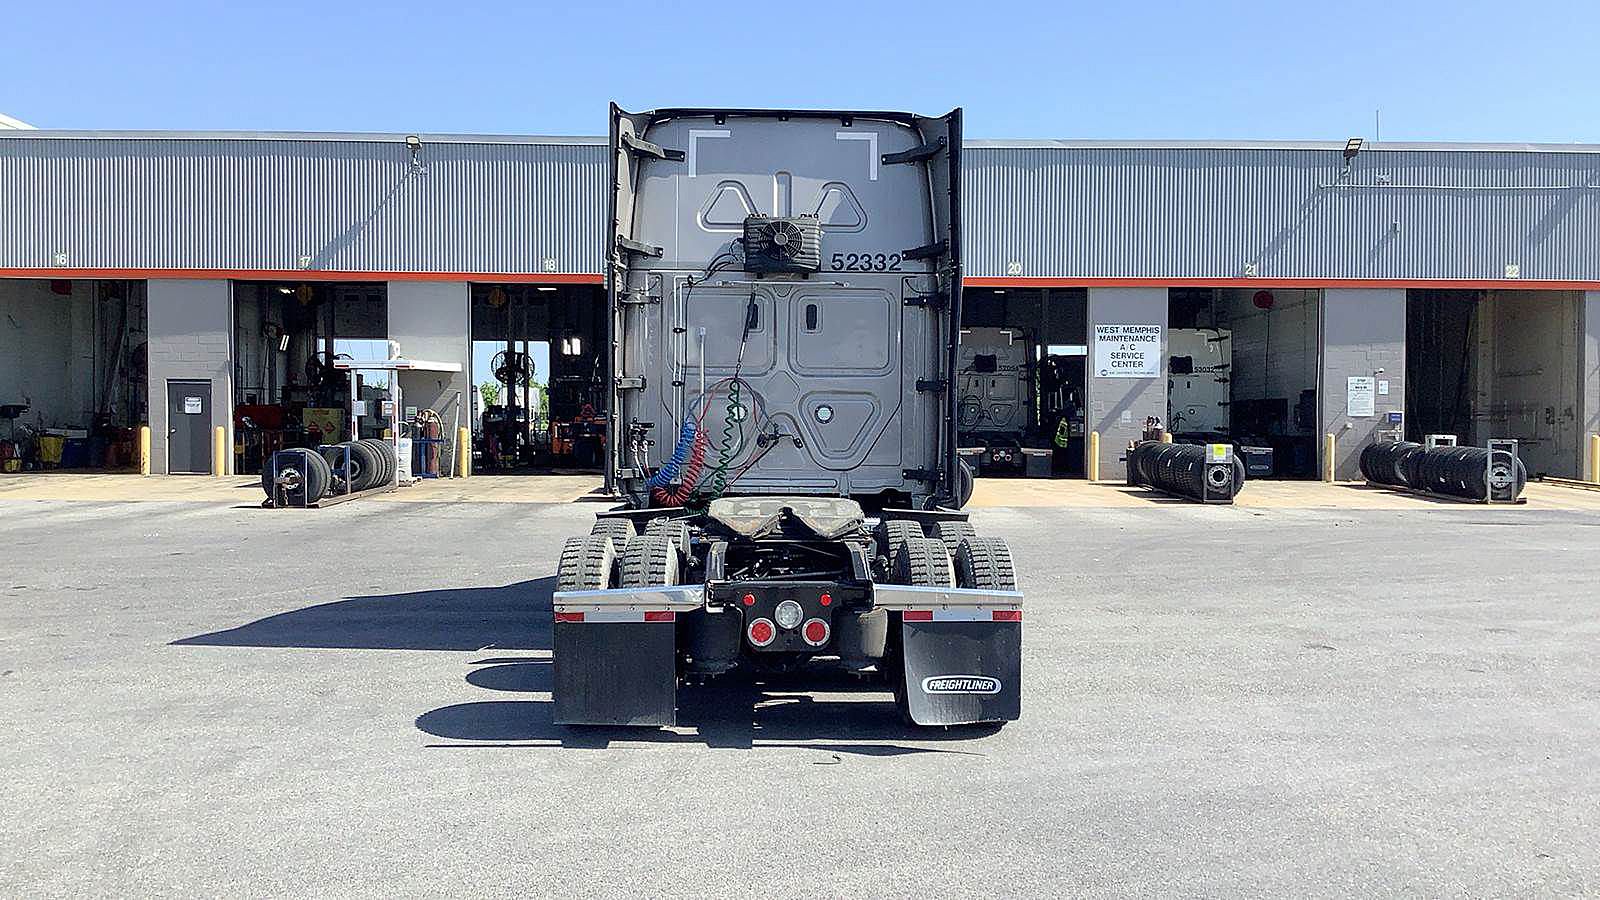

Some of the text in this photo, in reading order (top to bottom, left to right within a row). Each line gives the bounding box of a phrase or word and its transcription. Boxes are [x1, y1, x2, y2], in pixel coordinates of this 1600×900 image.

[54, 253, 67, 265] 16
[299, 256, 311, 267] 17
[543, 259, 556, 270] 18
[831, 253, 902, 271] 52332
[1008, 262, 1021, 275] 20
[1245, 263, 1258, 276] 21
[1096, 326, 1160, 335] WEST MEMPHIS
[1099, 335, 1157, 343] MAINTENANCE
[1110, 352, 1145, 360] SERVICE
[1111, 360, 1144, 368] CENTER
[928, 679, 994, 690] FREIGHTLINER
